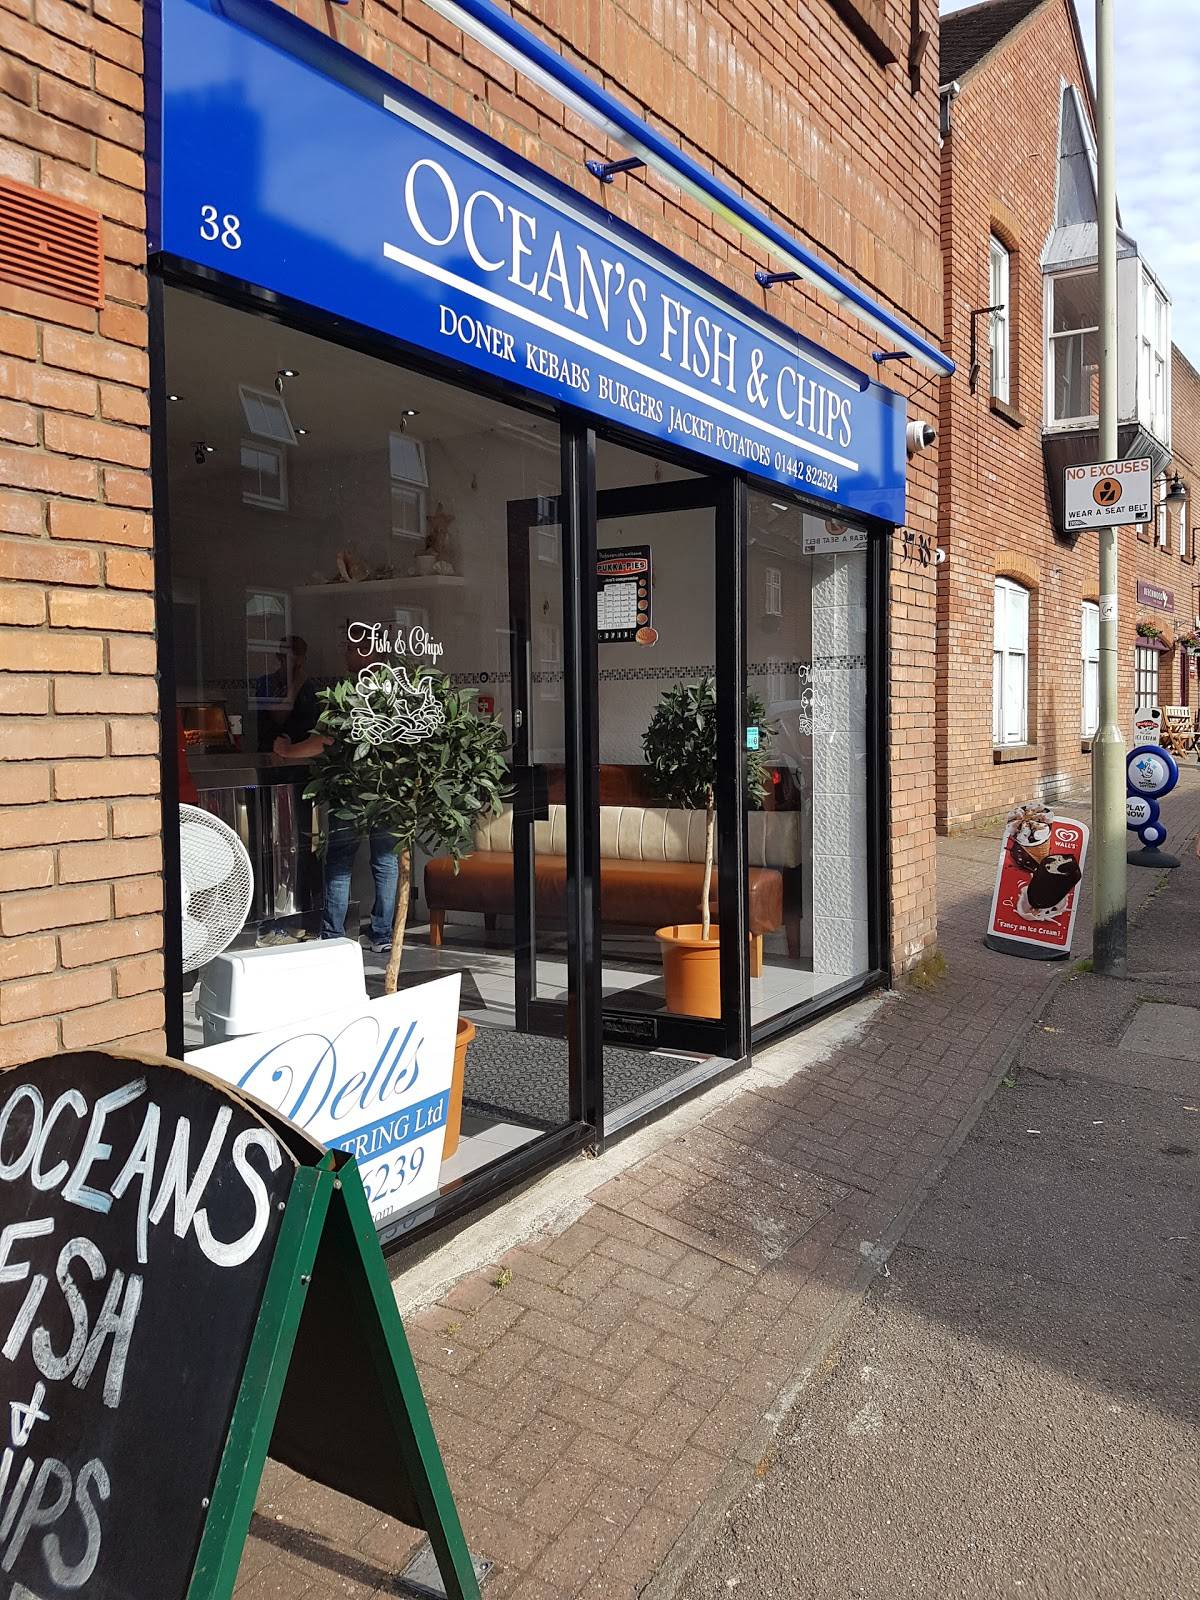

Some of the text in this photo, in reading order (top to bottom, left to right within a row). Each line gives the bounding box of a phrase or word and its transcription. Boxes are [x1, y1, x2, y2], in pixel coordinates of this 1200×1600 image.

[200, 204, 242, 250] 38
[404, 158, 853, 448] OCEAN'S FISH & CHIPS
[439, 304, 838, 493] DONER KEBABS BURGERS JACKET POTATOES 01442 822524
[1067, 460, 1149, 480] NO EXCUSES
[1068, 503, 1148, 519] WEAR A SEAT BELT
[347, 621, 444, 665] Fish & Chips
[1055, 840, 1076, 849] WALL'S
[1000, 920, 1018, 932] Fancy
[1038, 927, 1061, 937] Cream?
[236, 1015, 425, 1130] Dells
[414, 1098, 444, 1133] Ltd
[0, 1076, 283, 1267] OCEANS
[372, 1204, 394, 1222] om
[0, 1217, 144, 1408] FISH
